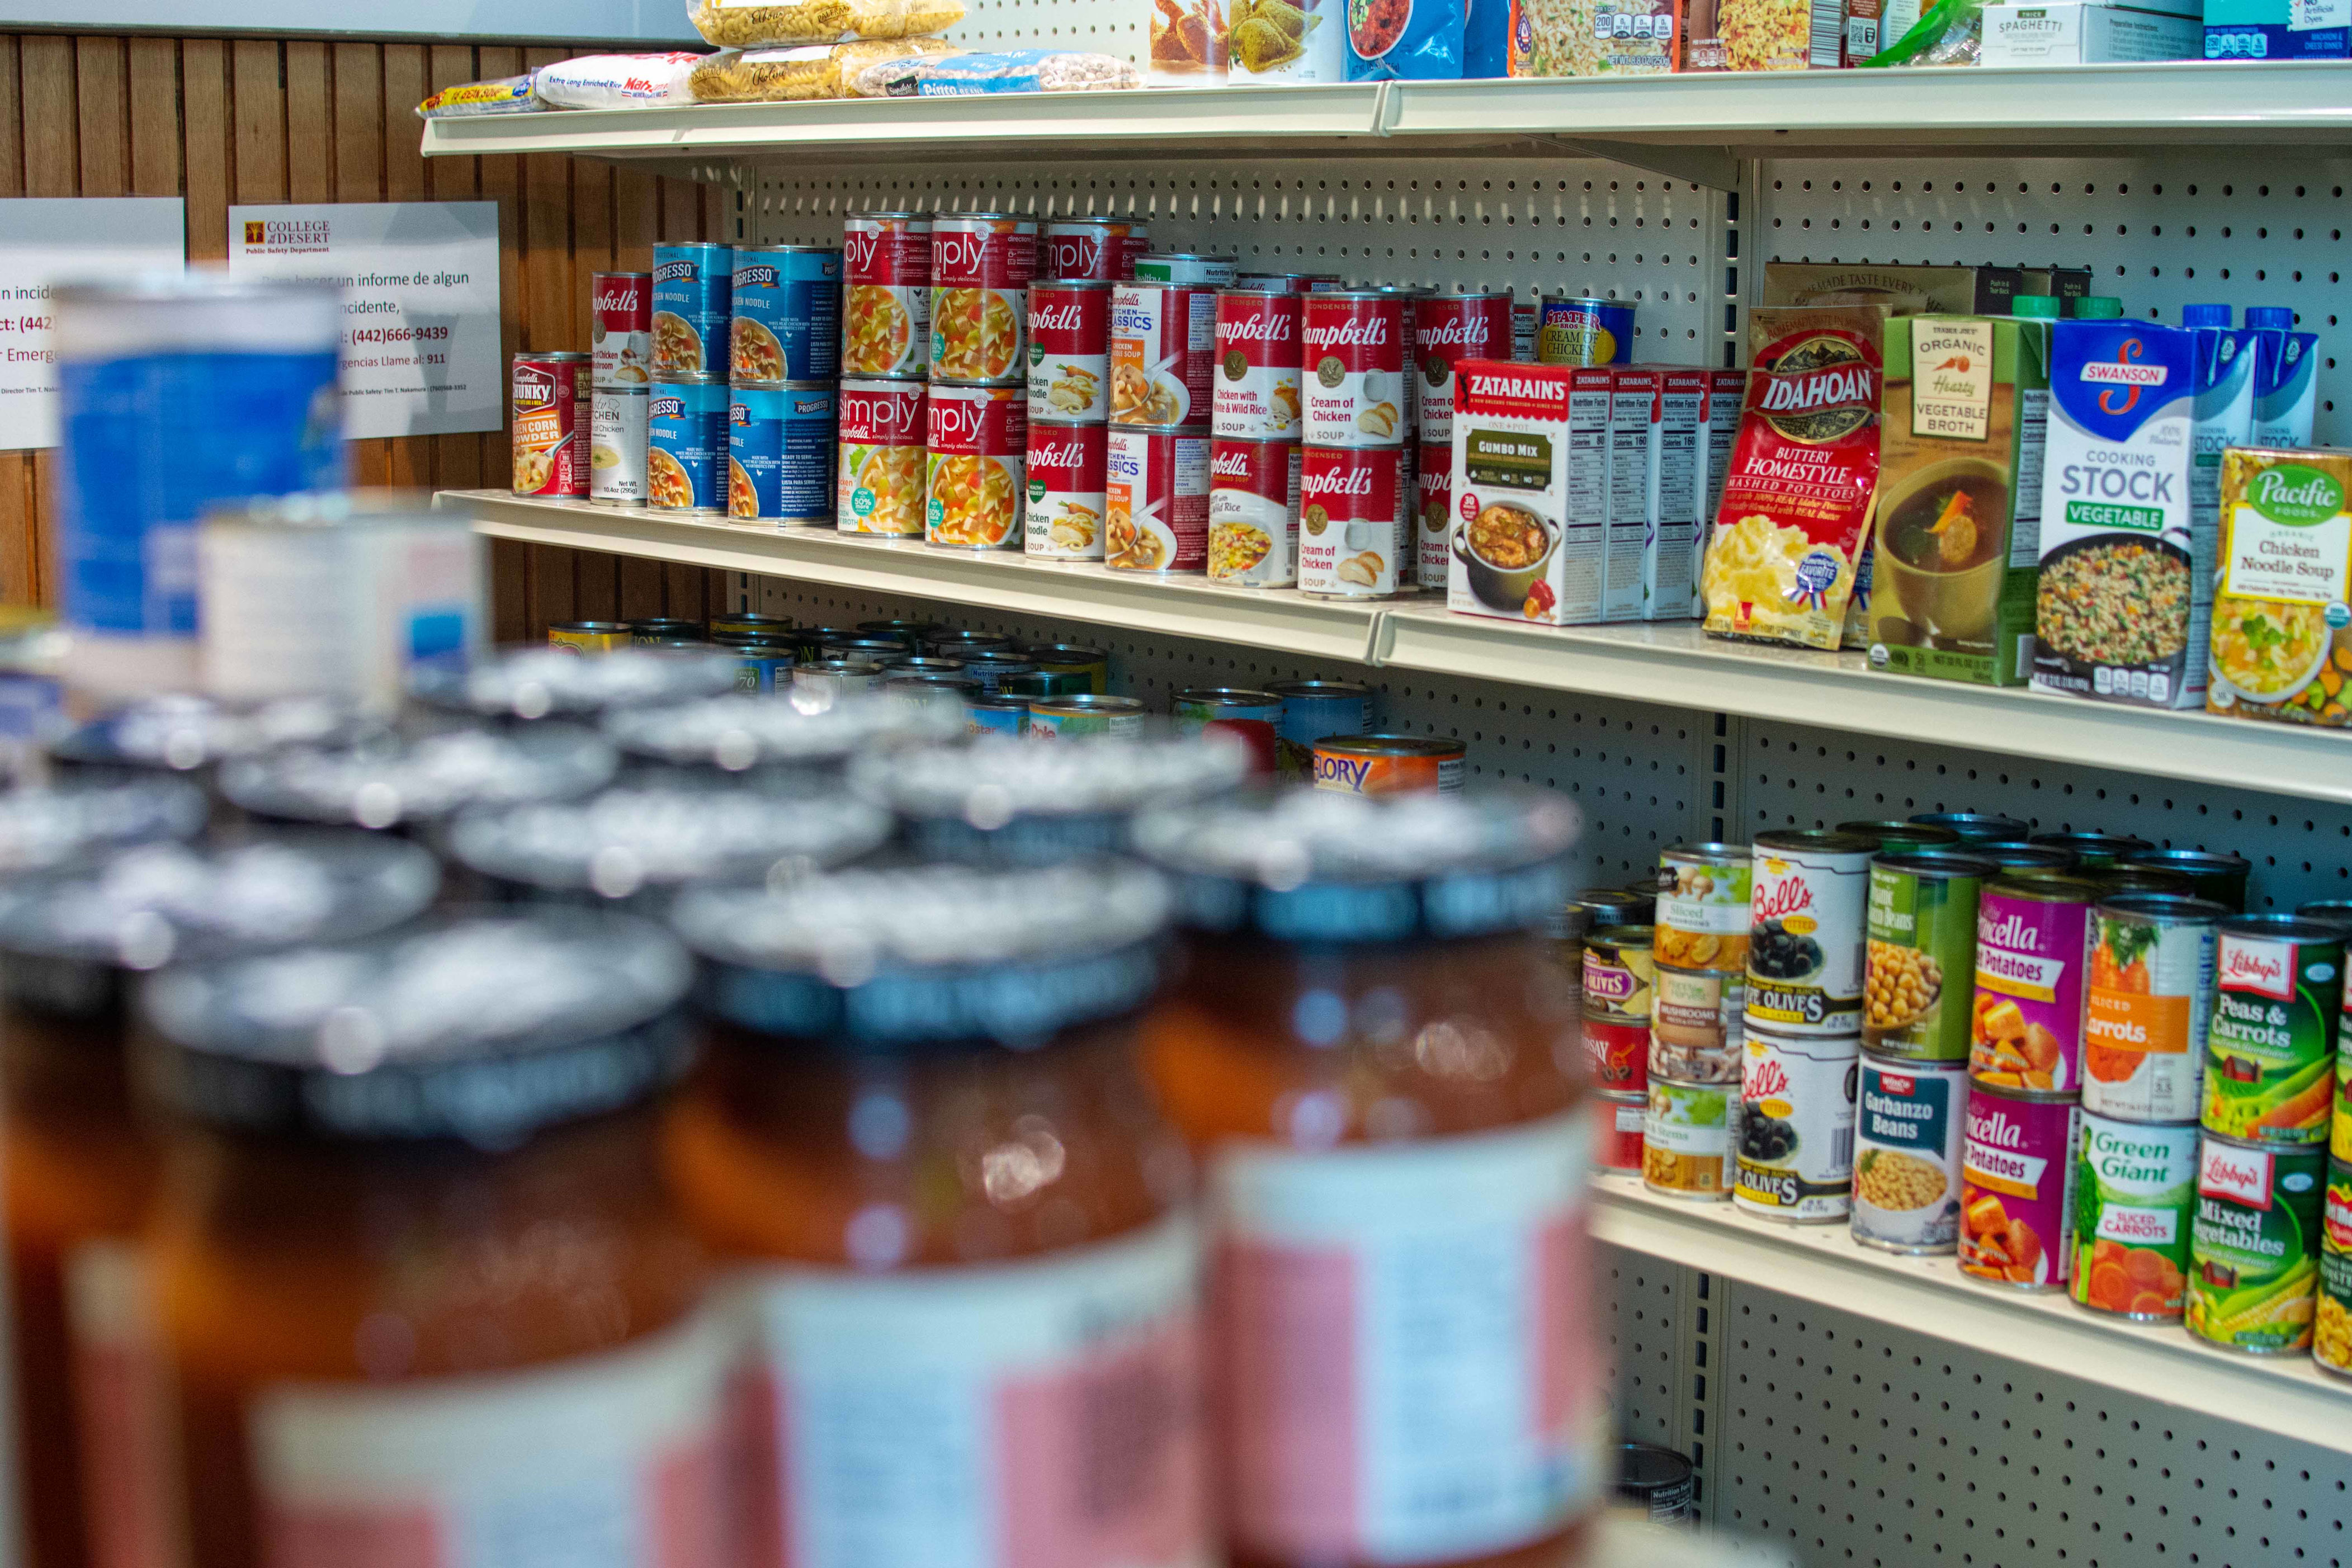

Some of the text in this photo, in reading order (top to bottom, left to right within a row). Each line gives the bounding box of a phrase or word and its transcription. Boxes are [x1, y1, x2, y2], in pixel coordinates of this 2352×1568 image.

[818, 6, 849, 23] PALERMO
[2304, 4, 2334, 15] Artificial
[1597, 17, 1610, 26] 200
[1999, 20, 2062, 32] SPAGHETTI
[2109, 18, 2132, 29] Preparation
[2304, 16, 2323, 25] Dyes
[1607, 56, 1670, 67] NET WT. 8.8 OZ (250g)
[549, 75, 622, 88] Extra Long Enriched Rice
[923, 84, 957, 96] Pinto
[267, 220, 330, 233] COLLEGE
[278, 233, 330, 244] DESERT
[337, 271, 469, 287] un informe de algun
[1850, 274, 1915, 294] TASTE EVERY
[665, 293, 689, 303] NOODLE
[745, 298, 771, 309] NOODLE
[339, 301, 399, 315] ncidente,
[1546, 310, 1600, 332] STATER
[352, 326, 448, 346] (442)666-9439
[1546, 330, 1600, 343] CREAM OF
[1547, 343, 1594, 356] CHICKEN
[1920, 339, 1985, 356] ORGANIC
[381, 353, 445, 367] Llame al: 911
[1576, 375, 1610, 385] ZATARAIN'S
[2087, 365, 2160, 382] SWANSON
[1470, 375, 1566, 401] ZATARAIN'S
[1619, 377, 1651, 386] ZATARAIN'S
[1933, 375, 1976, 397] Hearty
[514, 384, 551, 402] HUNKY
[1240, 390, 1257, 401] with
[1760, 369, 1873, 410] IDAHOAN
[799, 400, 828, 413] PROGRESSO
[1232, 400, 1267, 415] Wild Rice
[1311, 396, 1354, 408] Cream of
[1422, 396, 1446, 407] Cream
[1573, 398, 1606, 408] Nutrition Facts
[1615, 399, 1649, 408] Nutrition Facts
[1313, 410, 1351, 422] Chicken
[1917, 404, 1986, 419] VEGETABLE
[528, 419, 558, 432] CORN
[599, 425, 624, 433] Chicken
[1222, 423, 1245, 432] SOUP
[1929, 420, 1975, 433] BROTH
[656, 428, 677, 440] NOODLE
[1317, 431, 1344, 440] SOUP
[1428, 429, 1449, 438] SOUP
[1597, 436, 1605, 445] 80
[1635, 436, 1647, 446] 160
[1479, 441, 1538, 457] GUMBO MIX
[1776, 447, 1834, 464] BUTTERY
[2086, 451, 2156, 467] COOKING
[1744, 457, 1852, 485] HOMESTYLE
[2061, 465, 2174, 503] STOCK
[2256, 470, 2337, 508] Pacific
[1786, 484, 1855, 499] POTATOES
[1775, 495, 1796, 505] REAL
[1224, 503, 1240, 512] Rice
[1795, 507, 1816, 517] REAL
[2274, 507, 2315, 518] FOODS
[1027, 513, 1049, 524] Chicken
[2069, 506, 2160, 528] VEGETABLE
[1325, 546, 1335, 556] of
[2259, 541, 2320, 559] Chicken
[1302, 558, 1332, 570] Chicken
[1800, 564, 1836, 578] FAVORITE
[2240, 557, 2335, 581] Noodle Soup
[739, 676, 755, 688] 70
[1314, 754, 1373, 793] GLORY
[1753, 876, 1812, 925] Bell's
[1671, 904, 1703, 918] Sliced
[1784, 919, 1816, 932] PITTED
[1986, 950, 2043, 981] Potatoes
[2228, 948, 2281, 982] Libby's
[1764, 991, 1822, 1022] OLIVES
[2091, 995, 2131, 1012] SLICED
[2220, 994, 2287, 1026] Peas &
[1661, 1005, 1715, 1021] MUSHROOMS
[2088, 1016, 2146, 1043] arrots
[2212, 1013, 2291, 1048] Carrots
[1865, 1091, 1933, 1121] Garbanzo
[1872, 1114, 1919, 1140] Beans
[2096, 1132, 2169, 1159] Green
[1971, 1145, 2025, 1178] Potatoes
[2102, 1158, 2170, 1183] Giant
[2208, 1154, 2258, 1189] Libby's
[1745, 1172, 1798, 1205] OLIVES
[2117, 1212, 2156, 1225] SLICED
[2200, 1199, 2262, 1232] Mixed
[2105, 1220, 2167, 1238] CARROTS
[1653, 1488, 1680, 1499] Nutrition
